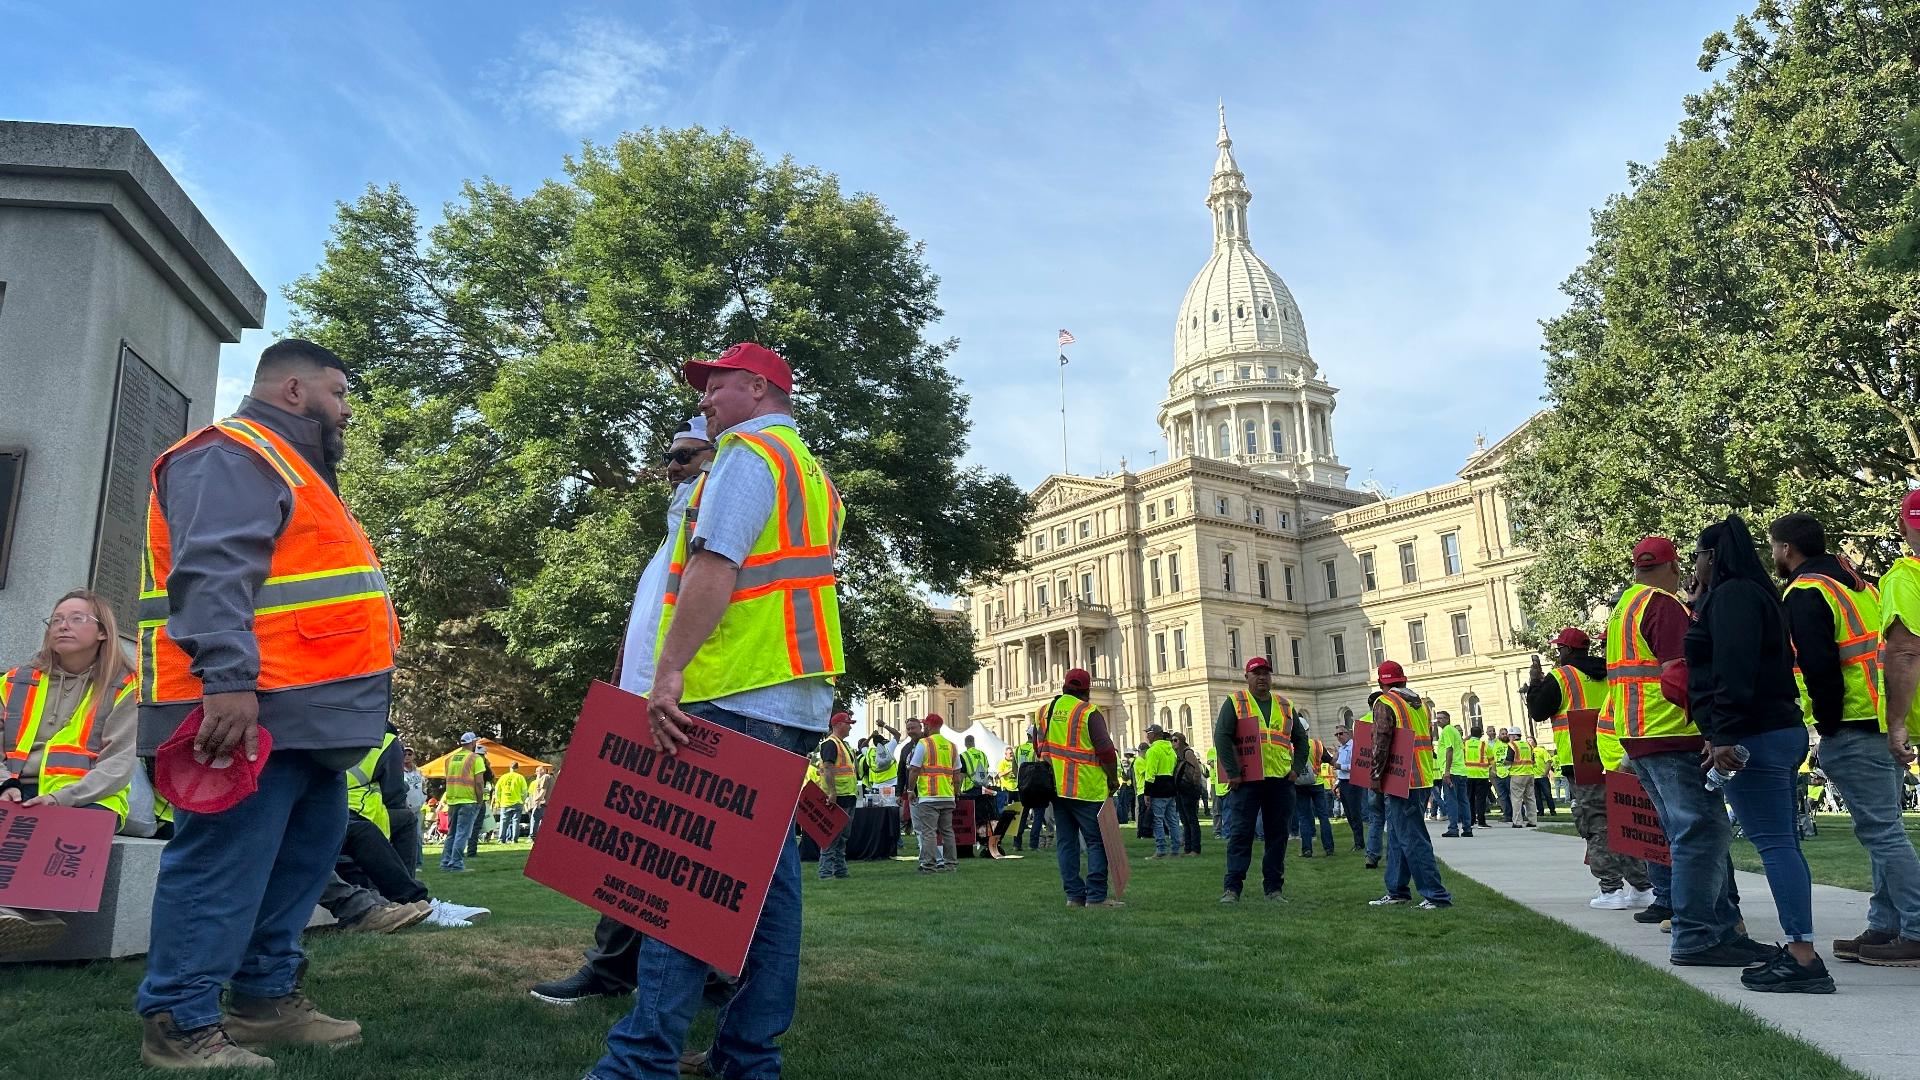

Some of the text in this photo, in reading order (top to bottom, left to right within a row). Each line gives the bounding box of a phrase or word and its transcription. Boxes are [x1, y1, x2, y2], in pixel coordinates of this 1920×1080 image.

[688, 724, 722, 745] AN'S
[598, 732, 758, 820] FUND CRITICAL
[5, 815, 39, 841] SAVE
[604, 780, 716, 851] ESSENTIAL
[0, 842, 28, 863] OUR
[55, 837, 87, 878] DAN'S
[556, 806, 748, 912] INFRASTRUCTURE
[592, 887, 670, 929] FUND OUR ROADS
[603, 874, 669, 913] SAVE OUR JOBS
